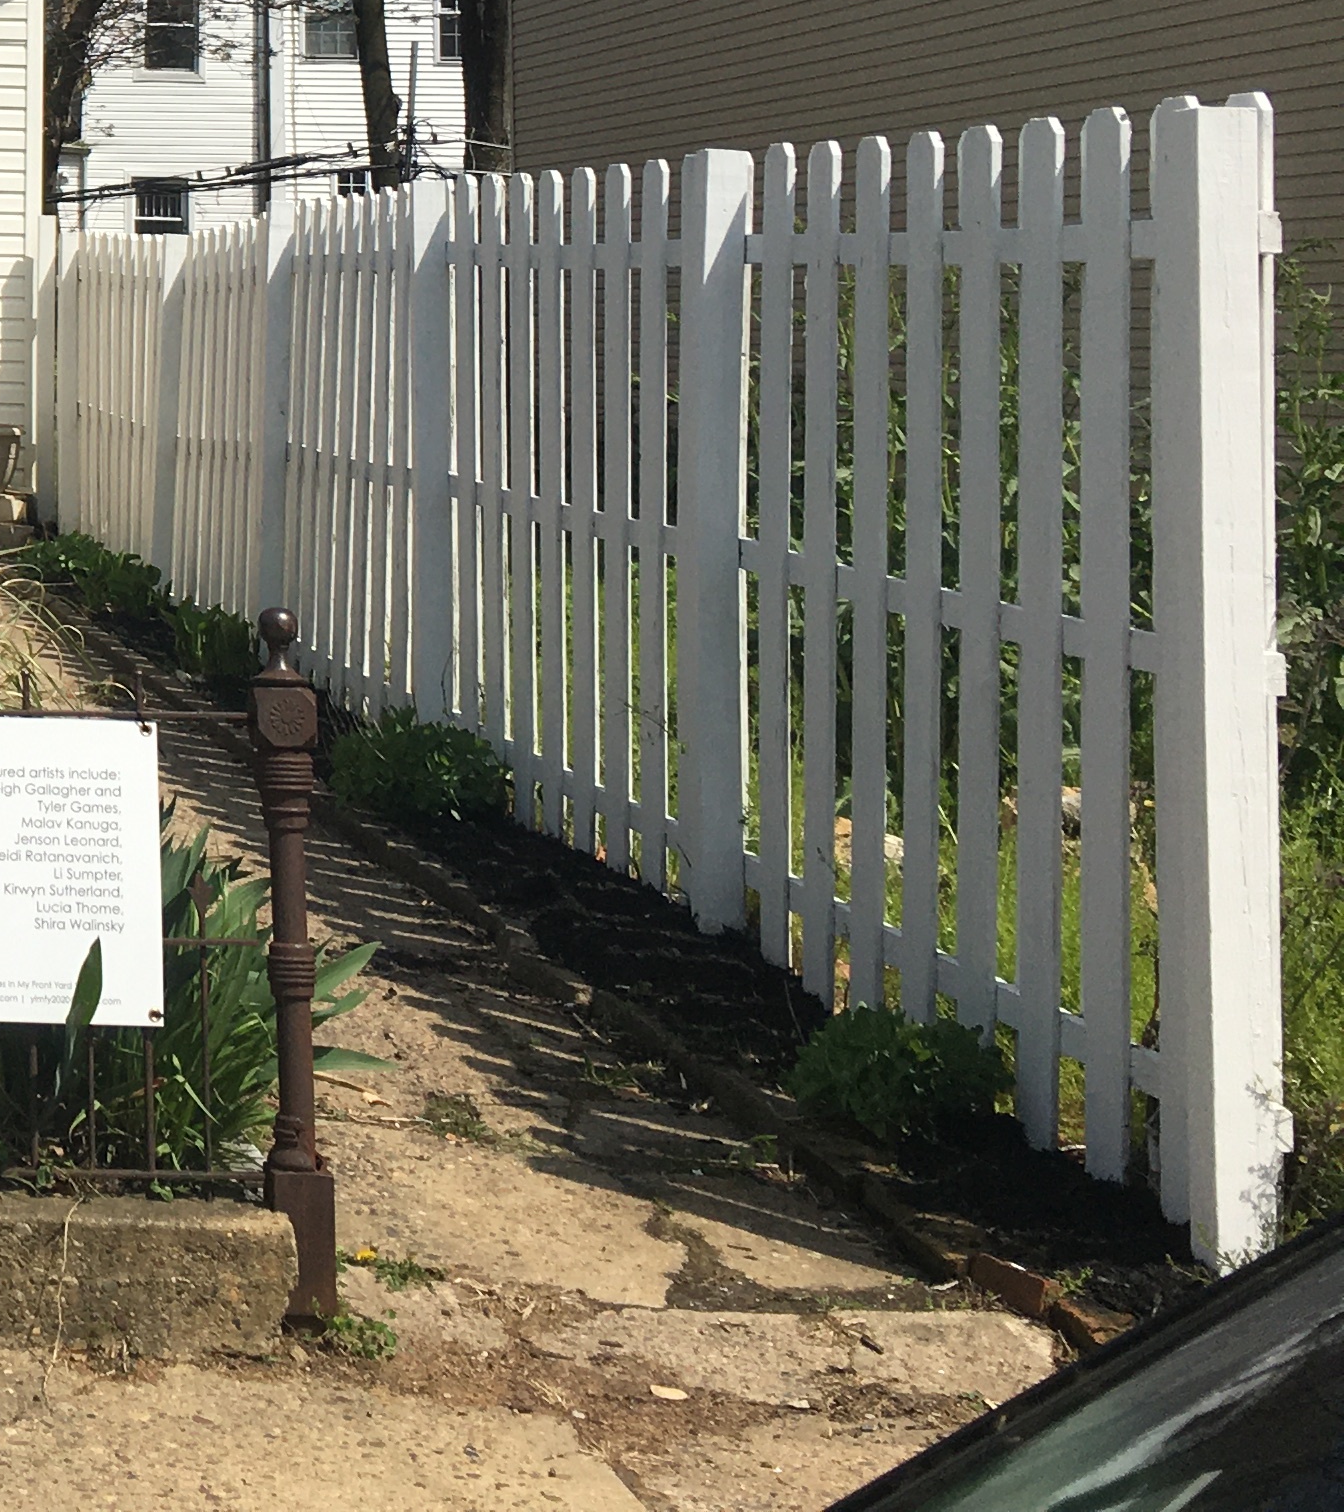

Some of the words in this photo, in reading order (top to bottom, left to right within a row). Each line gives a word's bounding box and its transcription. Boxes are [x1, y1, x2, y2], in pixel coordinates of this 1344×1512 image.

[29, 766, 65, 779] artists
[68, 767, 121, 781] include:
[24, 783, 91, 798] Gallagher
[94, 785, 121, 797] and
[37, 800, 67, 814] Tyler
[70, 800, 121, 815] Games,
[21, 817, 62, 829] Malav
[66, 818, 122, 833] Kanuga,
[14, 833, 60, 845] Jenson
[64, 834, 122, 848] Leonard,
[25, 850, 123, 865] Ratanavanich,
[53, 867, 63, 880] Li
[66, 868, 123, 883] Sumpter,
[3, 882, 45, 897] Kirwyn
[49, 883, 124, 899] Sutherland,
[36, 901, 72, 913] Lucia
[34, 917, 66, 930] Shira
[69, 918, 125, 934] Walinsky
